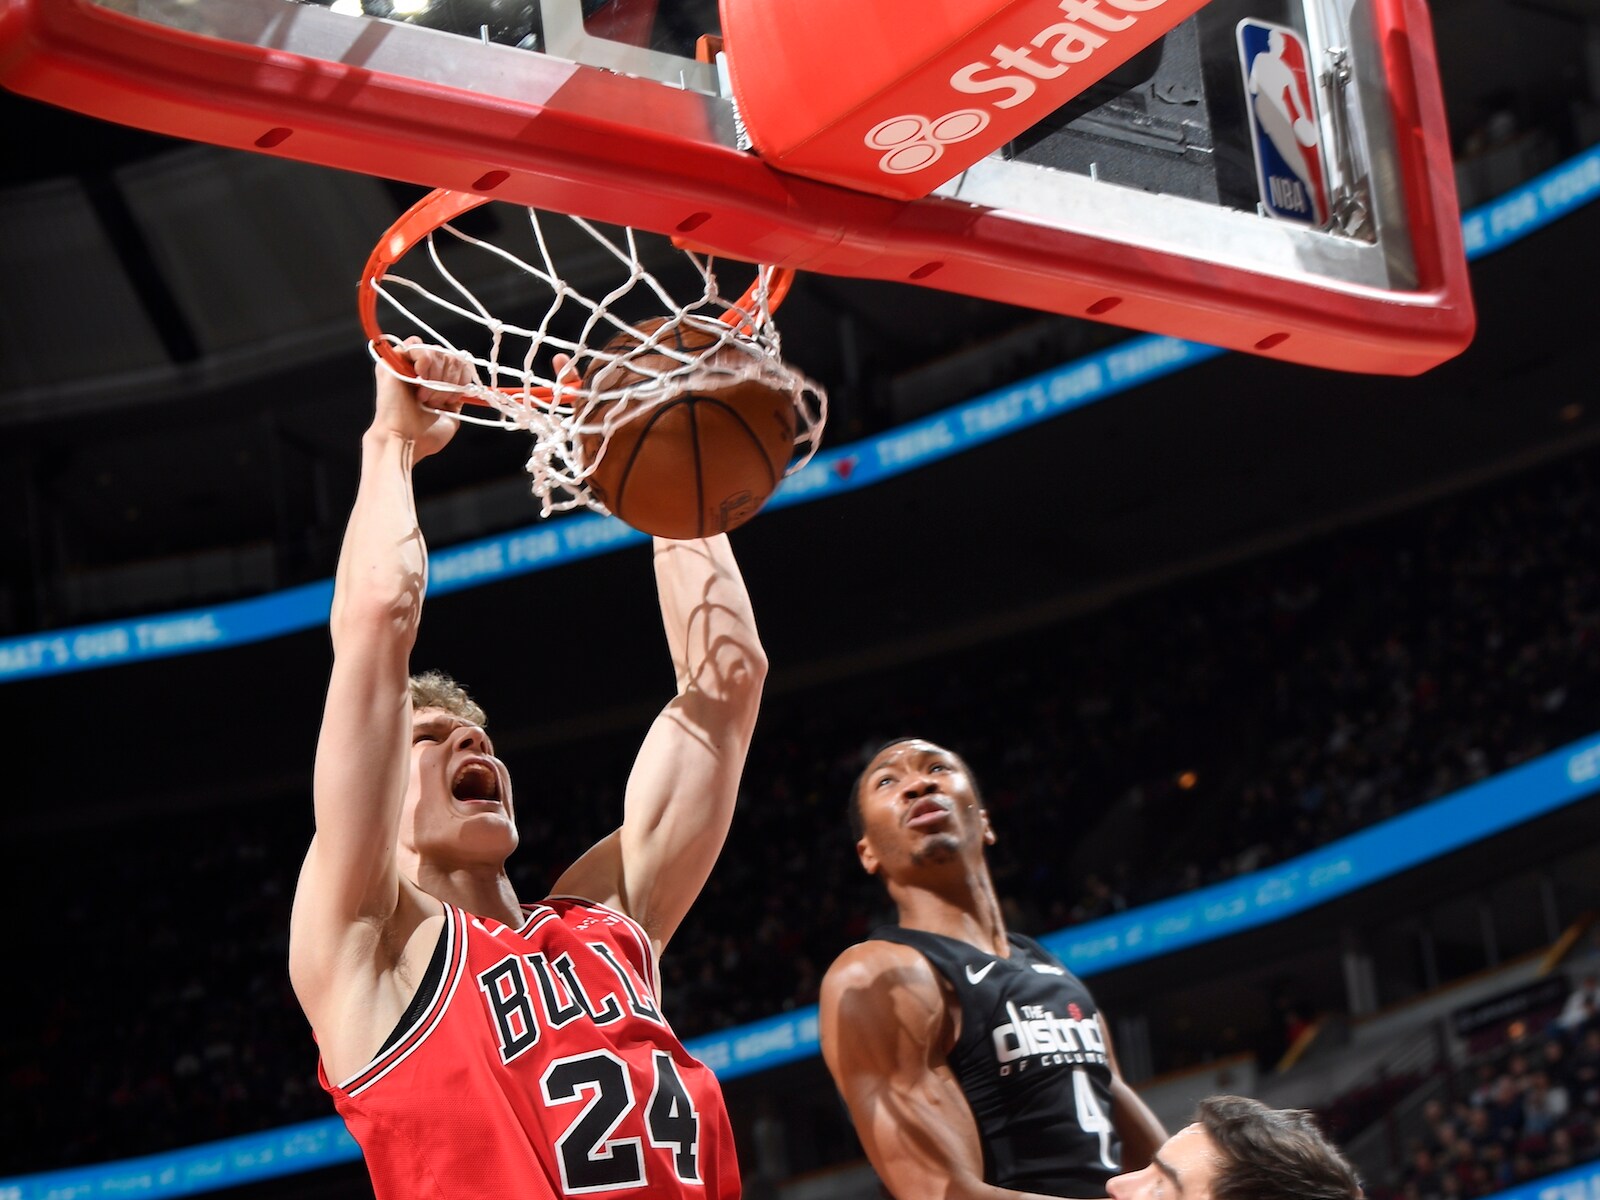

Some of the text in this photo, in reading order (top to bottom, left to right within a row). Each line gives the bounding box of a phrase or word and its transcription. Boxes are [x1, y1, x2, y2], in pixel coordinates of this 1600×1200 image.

[1269, 175, 1307, 213] NBA
[1020, 1004, 1045, 1020] THE
[539, 1048, 704, 1195] 24
[1072, 1064, 1122, 1171] 4
